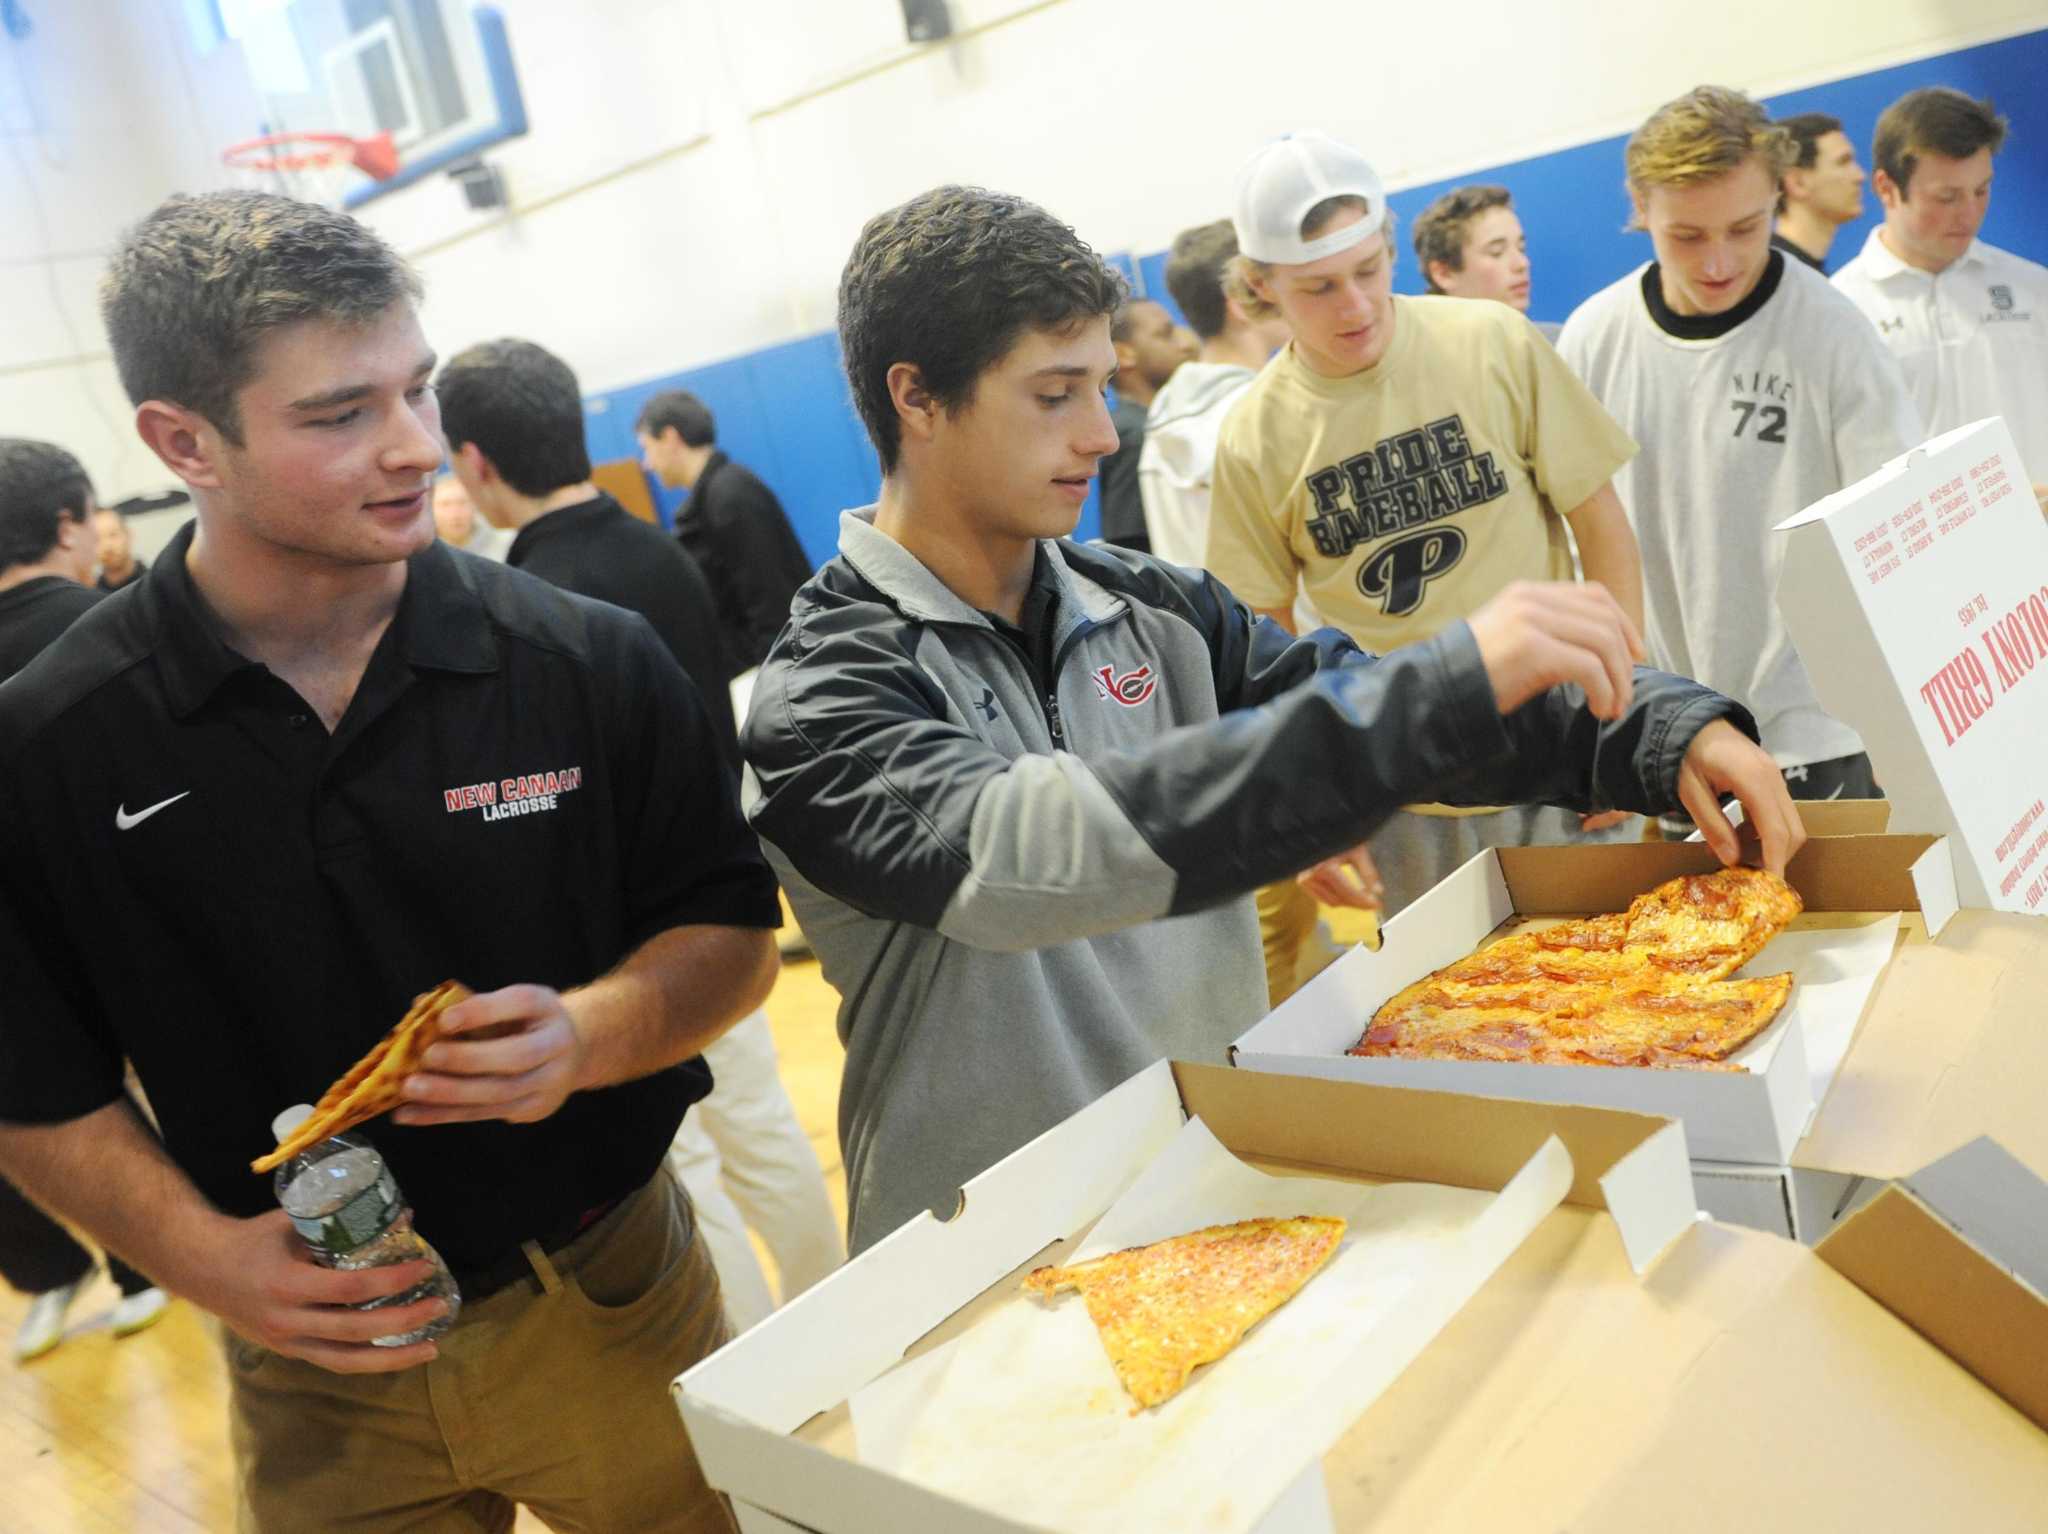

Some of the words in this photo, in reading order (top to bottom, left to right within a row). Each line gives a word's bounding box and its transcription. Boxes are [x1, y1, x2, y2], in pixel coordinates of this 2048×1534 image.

[1305, 414, 1473, 516] PRIDE
[1731, 400, 1787, 443] 72
[1355, 524, 1467, 617] P
[1981, 585, 2048, 694] OLONY
[1919, 646, 1994, 747] GRILL
[443, 782, 497, 812] NEW
[500, 766, 583, 803] CANAAN
[482, 794, 558, 822] LACROSSE
